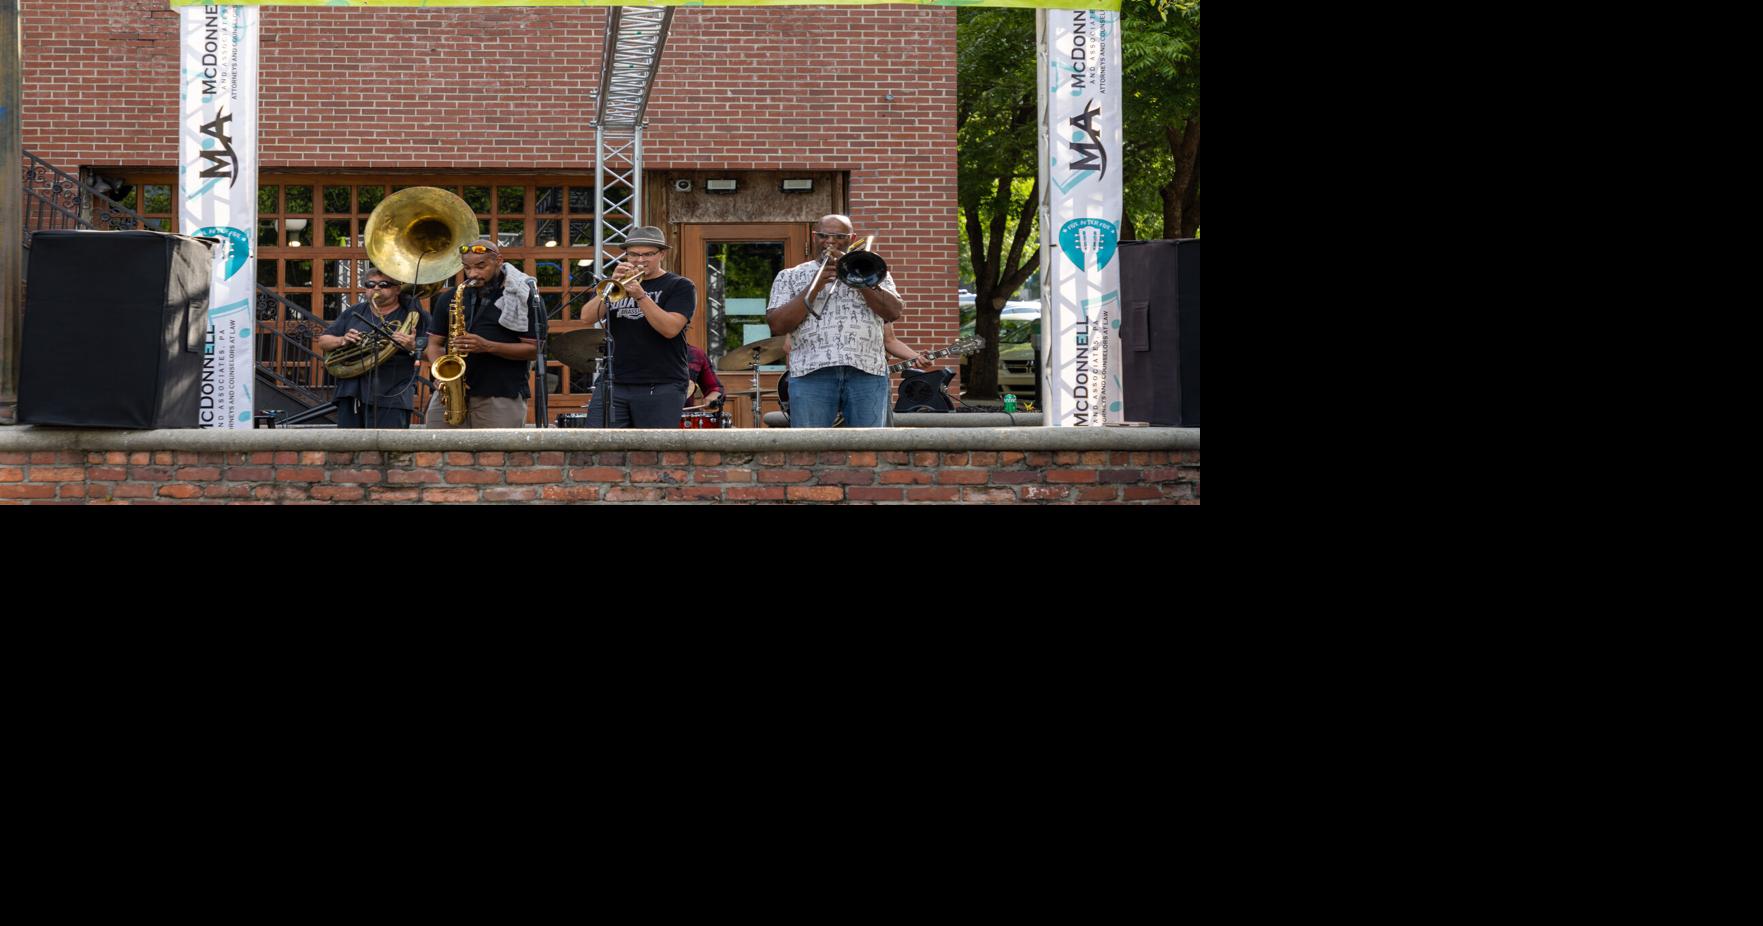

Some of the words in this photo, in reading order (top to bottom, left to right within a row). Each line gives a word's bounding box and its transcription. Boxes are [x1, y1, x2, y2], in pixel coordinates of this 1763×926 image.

[1069, 106, 1101, 171] MA
[199, 112, 233, 178] MA
[1093, 320, 1099, 331] PA
[1103, 326, 1109, 335] AT
[218, 329, 225, 341] PA
[229, 336, 236, 344] AT
